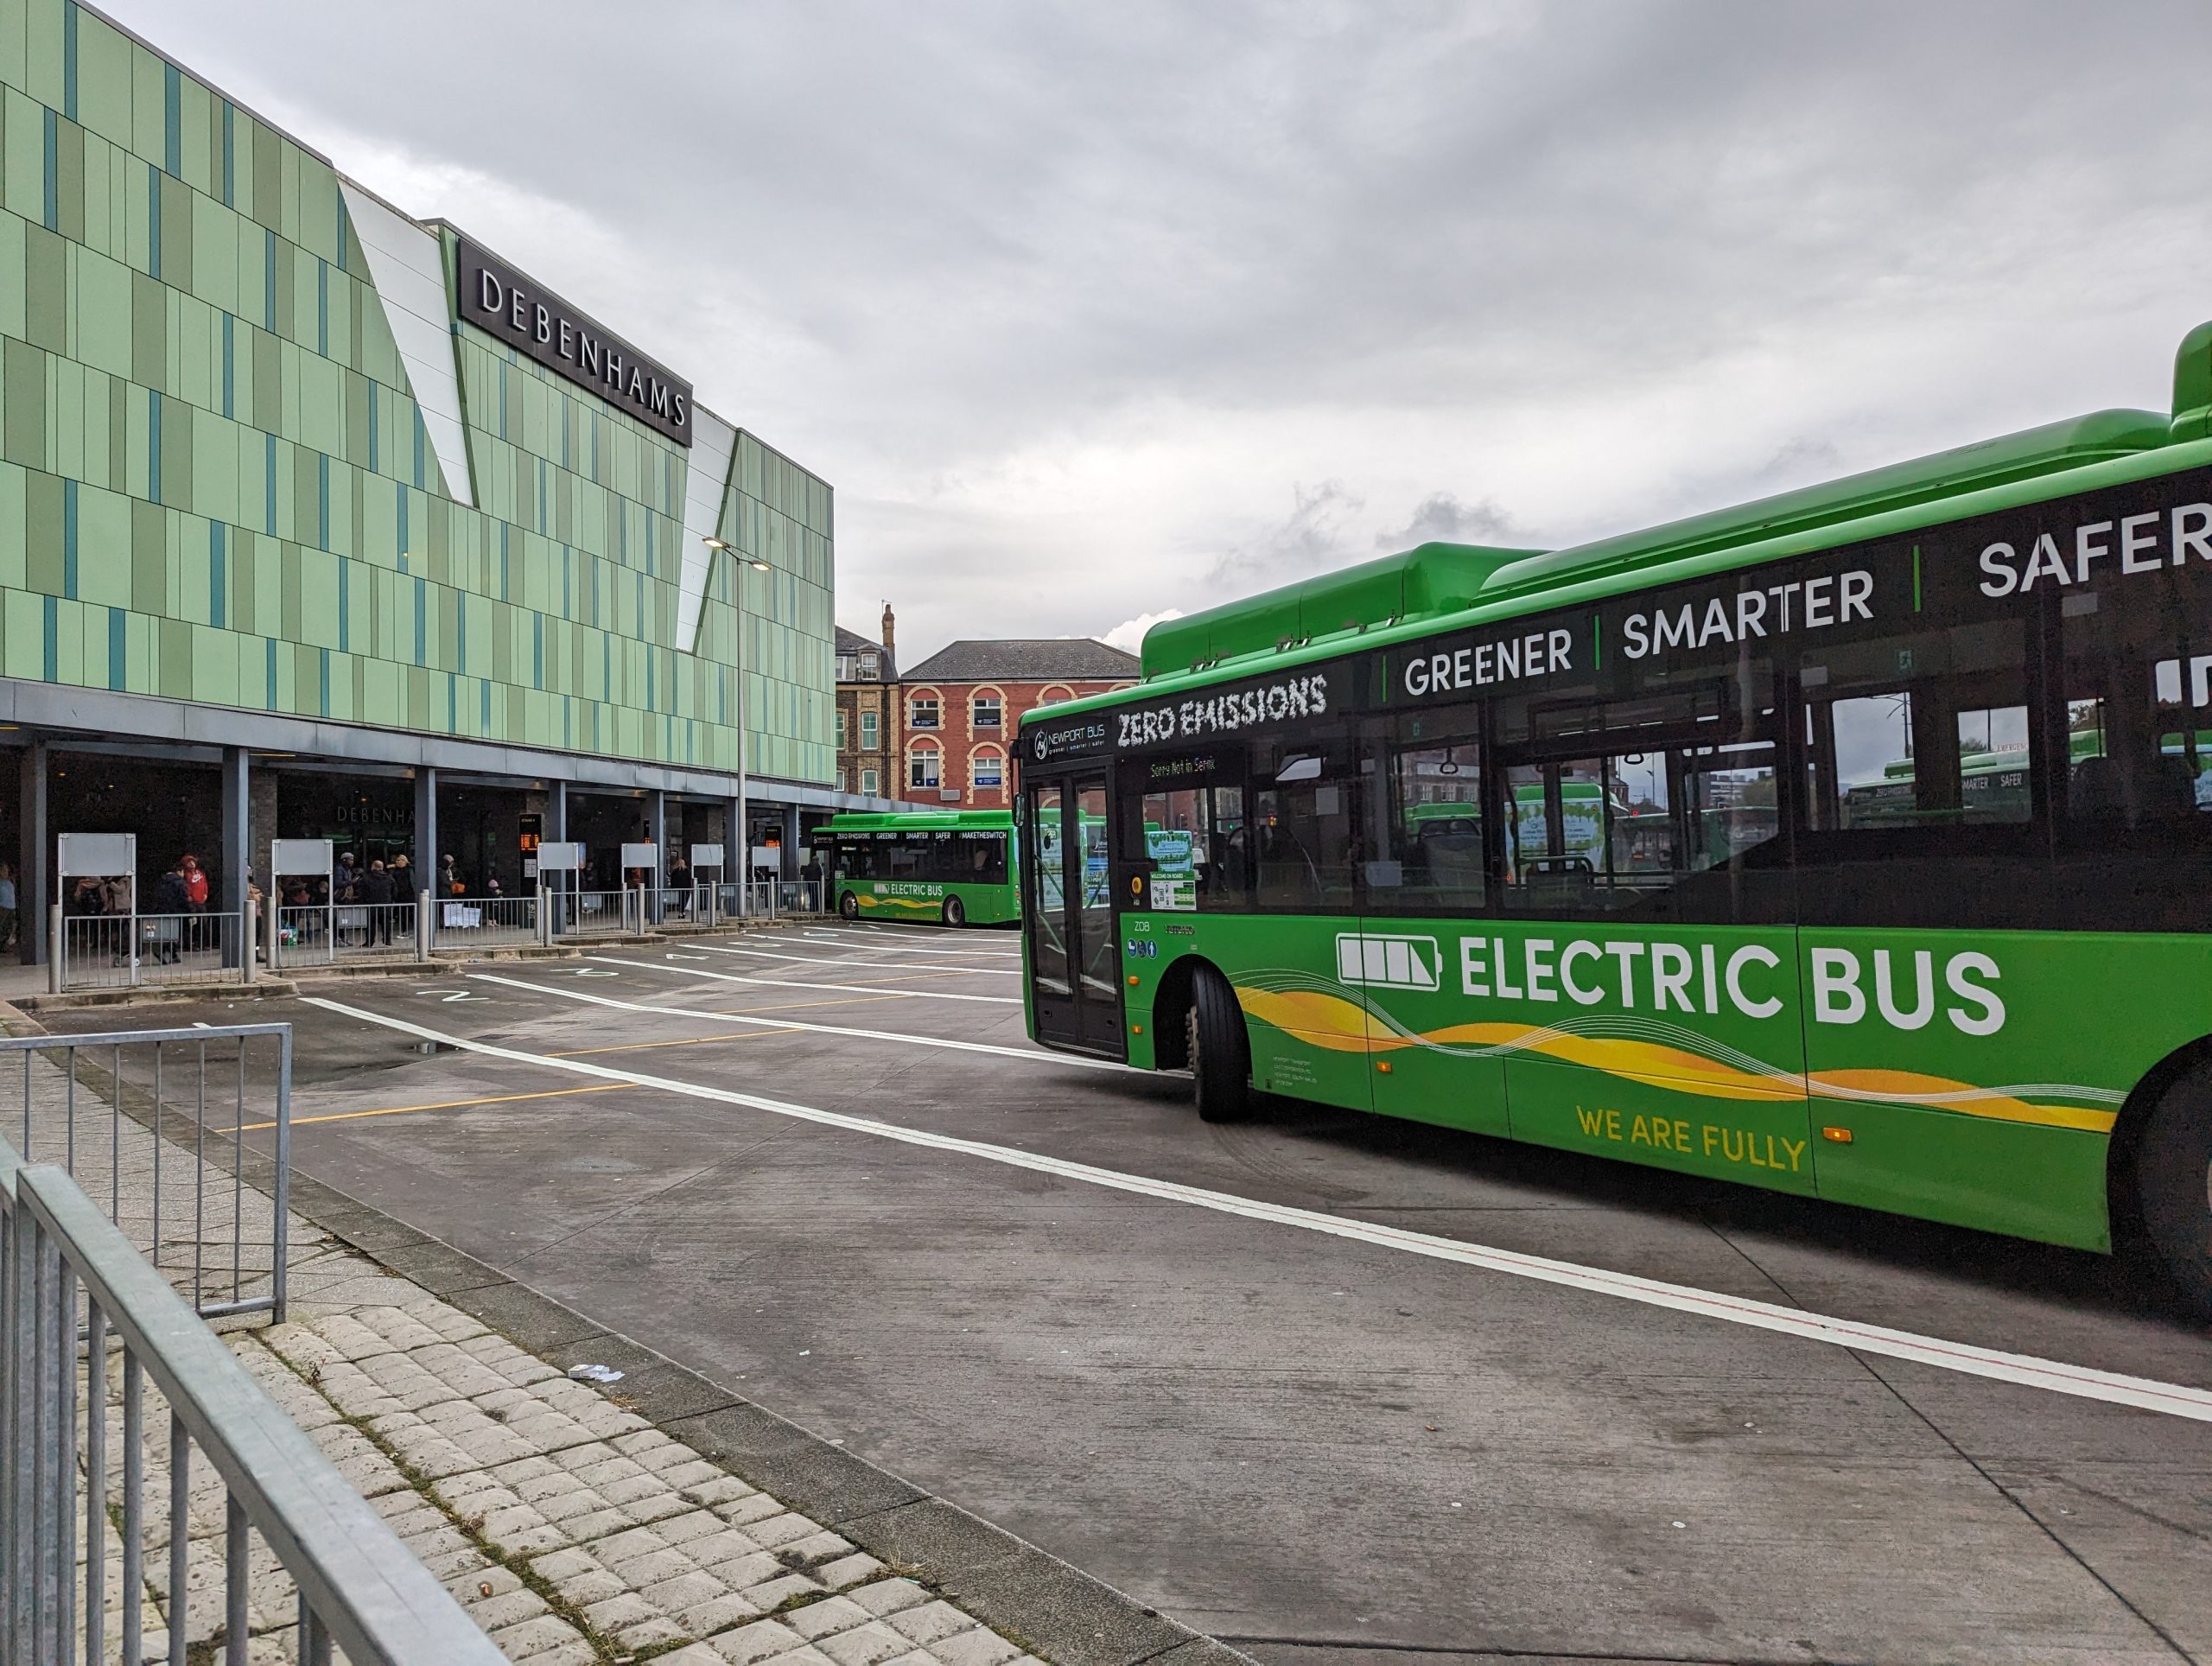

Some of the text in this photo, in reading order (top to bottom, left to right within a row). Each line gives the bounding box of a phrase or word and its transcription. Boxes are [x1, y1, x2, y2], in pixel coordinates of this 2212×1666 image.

[480, 268, 685, 427] DEBENHAMS
[1117, 502, 2212, 747] ZERO EMISSIONS GREENER SMARTER SAFER
[1048, 723, 1105, 745] NEWPORT BUS
[2000, 773, 2022, 787] SAFER
[891, 883, 943, 896] ELECTRIC BUS
[549, 968, 620, 977] 3
[416, 990, 490, 1002] 2
[1459, 937, 2005, 1036] ELECTRIC BUS
[1576, 1105, 1806, 1172] WE ARE FULLY
